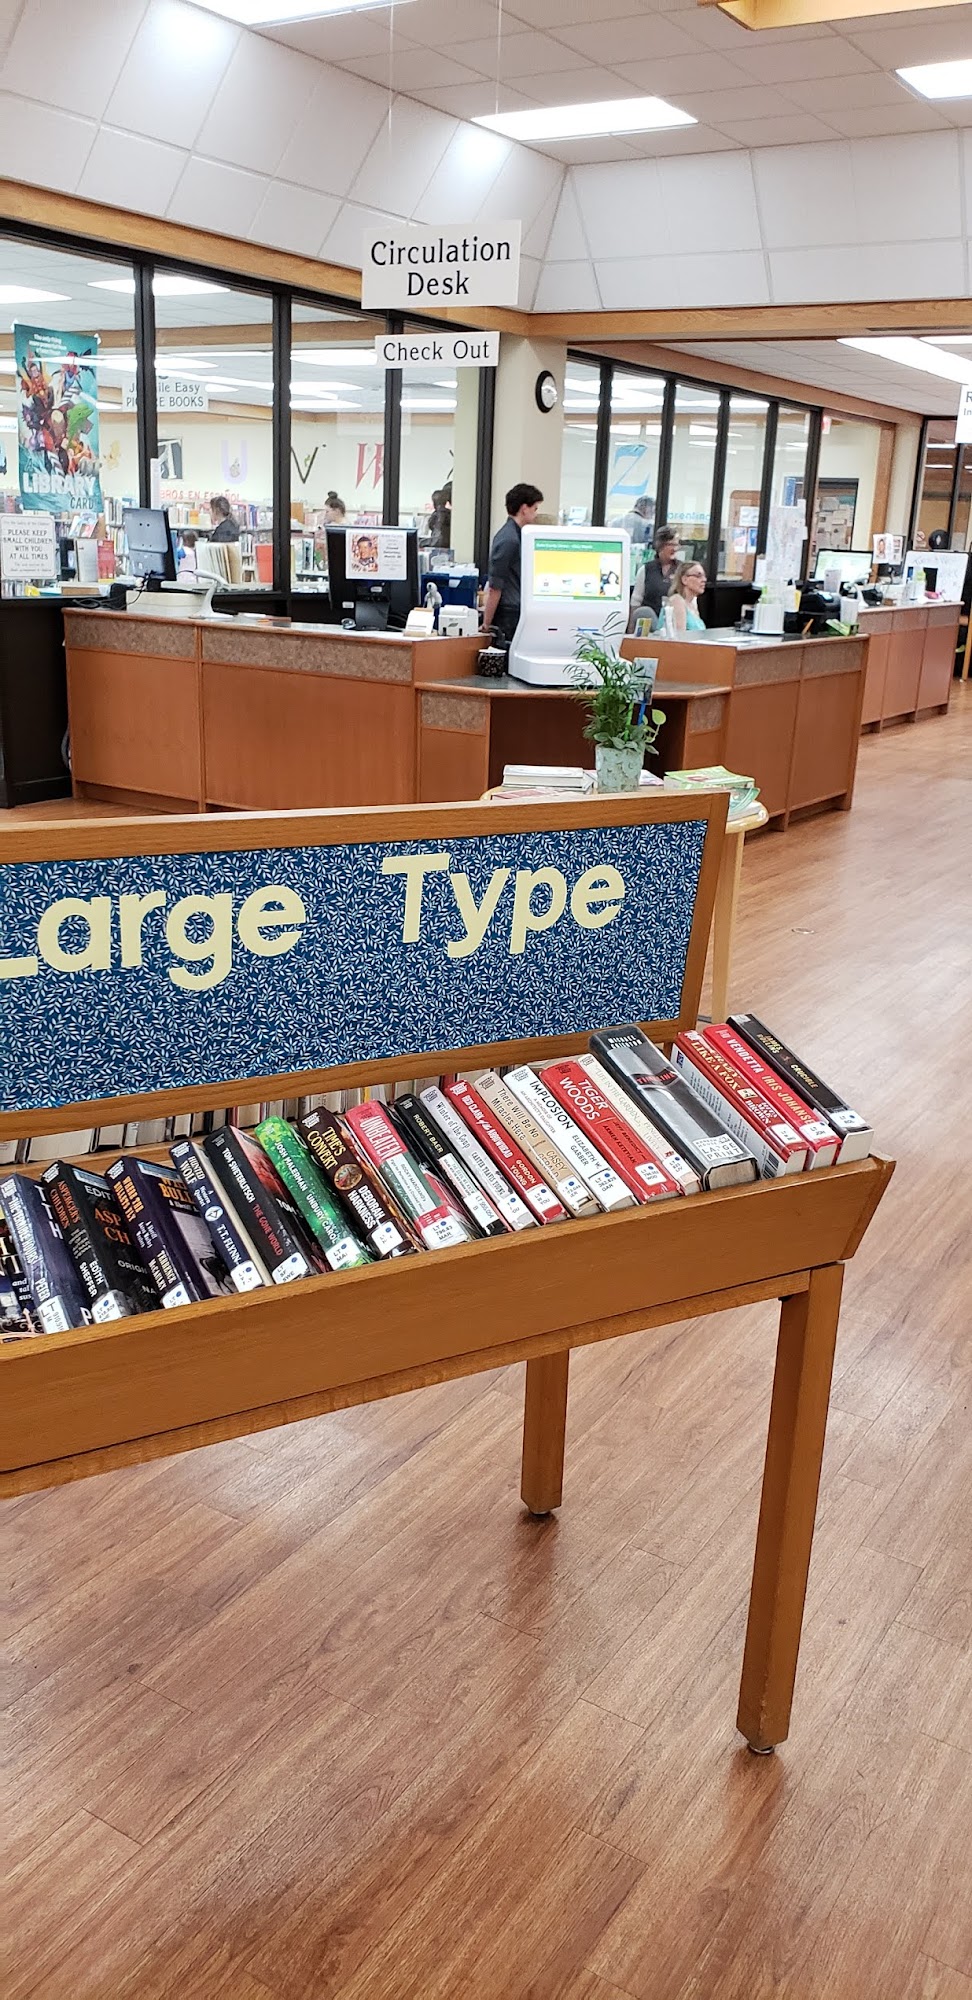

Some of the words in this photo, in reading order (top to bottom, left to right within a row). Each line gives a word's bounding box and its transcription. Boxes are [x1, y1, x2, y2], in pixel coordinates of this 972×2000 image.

[371, 236, 510, 266] Circulation
[407, 270, 470, 296] Desk
[383, 341, 444, 362] Check
[453, 340, 490, 359] Out
[169, 396, 204, 408] BOOKS
[175, 382, 201, 395] Easy
[23, 472, 97, 497] LIBRARY
[70, 497, 94, 510] CARD
[24, 537, 53, 545] CHILDREN
[32, 529, 48, 537] KEEP
[0, 885, 306, 991] arge
[382, 852, 626, 959] Type
[608, 1034, 637, 1044] MICHAEL
[756, 1034, 779, 1054] ROLLINS
[764, 1036, 784, 1051] JAMES
[691, 1042, 714, 1063] LIKE
[711, 1060, 721, 1071] A
[718, 1071, 740, 1090] FOX
[790, 1064, 818, 1088] CRUCIBLE
[578, 1079, 610, 1110] TIGER
[727, 1039, 764, 1073] VENDETTA
[762, 1076, 782, 1091] IRIS
[777, 1092, 814, 1126] JOHANSE
[497, 1088, 514, 1106] There
[511, 1105, 525, 1120] Will
[528, 1128, 539, 1138] No
[529, 1080, 574, 1130] IMPLOSION
[559, 1077, 600, 1120] WOODS
[745, 1100, 771, 1124] BROWN
[413, 1114, 433, 1137] ROBERT
[429, 1136, 444, 1153] BAER
[468, 1104, 484, 1120] CLARK
[486, 1129, 513, 1158] ARROWHEAD
[491, 1097, 514, 1126] Miracles
[511, 1123, 526, 1141] Here
[307, 1130, 338, 1170] CONVERT
[322, 1126, 346, 1156] TIME'S
[360, 1115, 403, 1160] UNBEATEN
[436, 1101, 451, 1121] Winter
[458, 1134, 470, 1149] Coup
[471, 1152, 486, 1168] CARTER
[482, 1166, 496, 1182] TRAVIS
[492, 1180, 506, 1195] YOUNG
[572, 1134, 597, 1162] ELIZABETH
[602, 1125, 619, 1141] ARMEN
[616, 1141, 637, 1164] KETEYIAN
[621, 1132, 642, 1154] BENEDICT
[188, 1156, 205, 1180] HUNTED
[535, 1153, 559, 1180] GERALD
[546, 1150, 567, 1171] CASEY
[570, 1145, 589, 1166] GARBER
[707, 1148, 740, 1160] PRINT
[180, 1160, 198, 1184] WOLF
[510, 1165, 527, 1186] YOUNG
[516, 1160, 537, 1184] GORDON
[57, 1180, 81, 1223] ASPERGER'S
[85, 1186, 115, 1201] EDIT
[222, 1147, 234, 1163] TOM
[228, 1160, 256, 1203] SWETERLITSCH
[252, 1204, 264, 1218] THE
[259, 1216, 272, 1234] GONE
[268, 1232, 283, 1256] WORLD
[274, 1141, 288, 1158] JOSH
[283, 1156, 308, 1192] MALERMAN
[306, 1193, 325, 1221] UNBURY
[320, 1220, 338, 1244] CAROL
[358, 1185, 386, 1221] DEBORAH
[50, 1188, 70, 1229] CHILDREN
[347, 1190, 376, 1229] HARKNESS
[216, 1224, 229, 1240] T.T.
[223, 1237, 241, 1263] FLYNN
[79, 1261, 98, 1298] SHEFFER
[89, 1260, 105, 1285] EDITH
[148, 1258, 167, 1291] McCAULEY
[157, 1250, 177, 1284] TERRENCE
[35, 1277, 51, 1302] PETER
